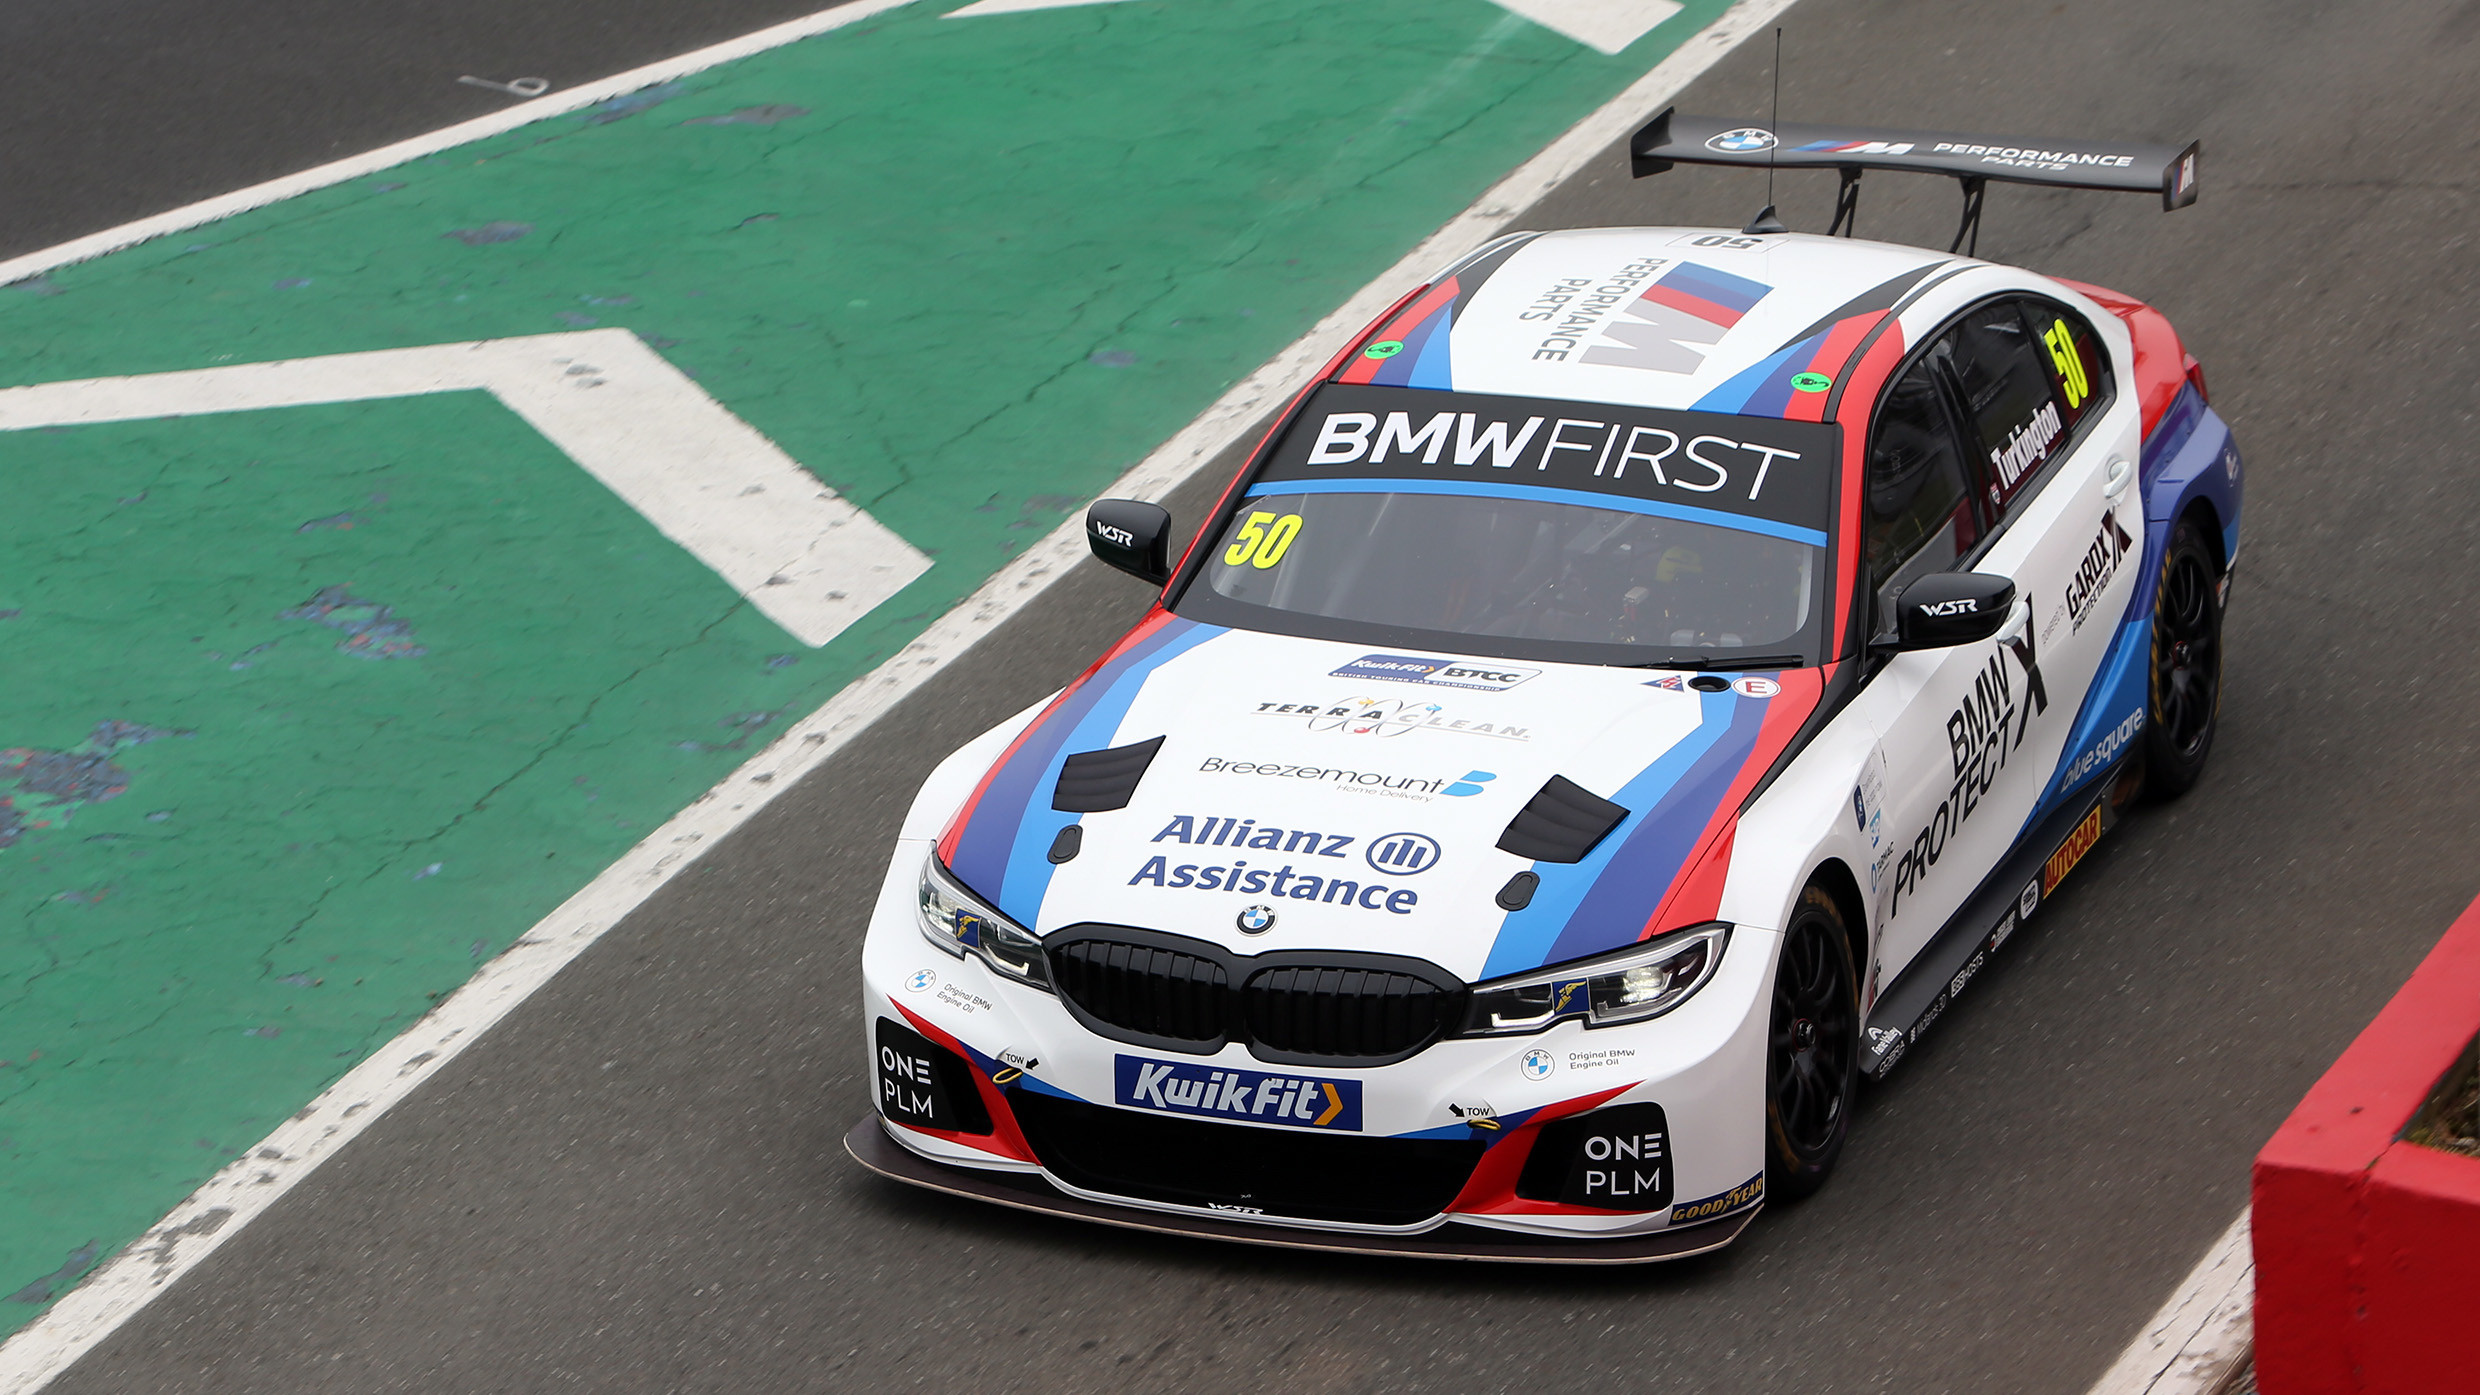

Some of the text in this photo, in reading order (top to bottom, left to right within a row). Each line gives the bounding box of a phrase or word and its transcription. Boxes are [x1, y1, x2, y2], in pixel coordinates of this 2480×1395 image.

[1933, 143, 2135, 167] PERFORMANCE
[1981, 156, 2069, 171] PARTS
[1691, 235, 1764, 249] 50
[1519, 278, 1592, 321] PARTS
[1532, 257, 1668, 362] PERFORMANCE
[2044, 319, 2089, 409] 50
[1990, 401, 2062, 490] Turkington
[1096, 520, 1133, 547] WSR
[1223, 511, 1303, 569] 50
[2066, 527, 2111, 620] GARDX
[1919, 598, 1978, 617] WSR
[1371, 675, 1410, 683] TOURING
[1432, 681, 1500, 692] CHAMPIONSHIP
[1444, 668, 1521, 683] BTCC
[1745, 681, 1767, 694] E
[1946, 640, 2011, 781] BMW
[1199, 757, 1445, 793] Breezemount
[1337, 784, 1434, 803] Home Delivery
[1891, 702, 2015, 920] PROTECT
[1150, 815, 1355, 858] Allianz
[2044, 812, 2098, 897] AUTOCAR
[1127, 855, 1418, 914] Assistance
[937, 991, 975, 1014] Engine Oil
[943, 983, 993, 1011] Original BMW
[882, 1046, 931, 1085] ONE
[1006, 1053, 1025, 1065] TOW
[1569, 1049, 1635, 1062] Original BMW
[1570, 1058, 1619, 1070] Engine Oil
[885, 1077, 933, 1119] PLM
[1467, 1107, 1489, 1116] TOW
[1585, 1133, 1662, 1161] ONE
[1586, 1167, 1660, 1195] PLM
